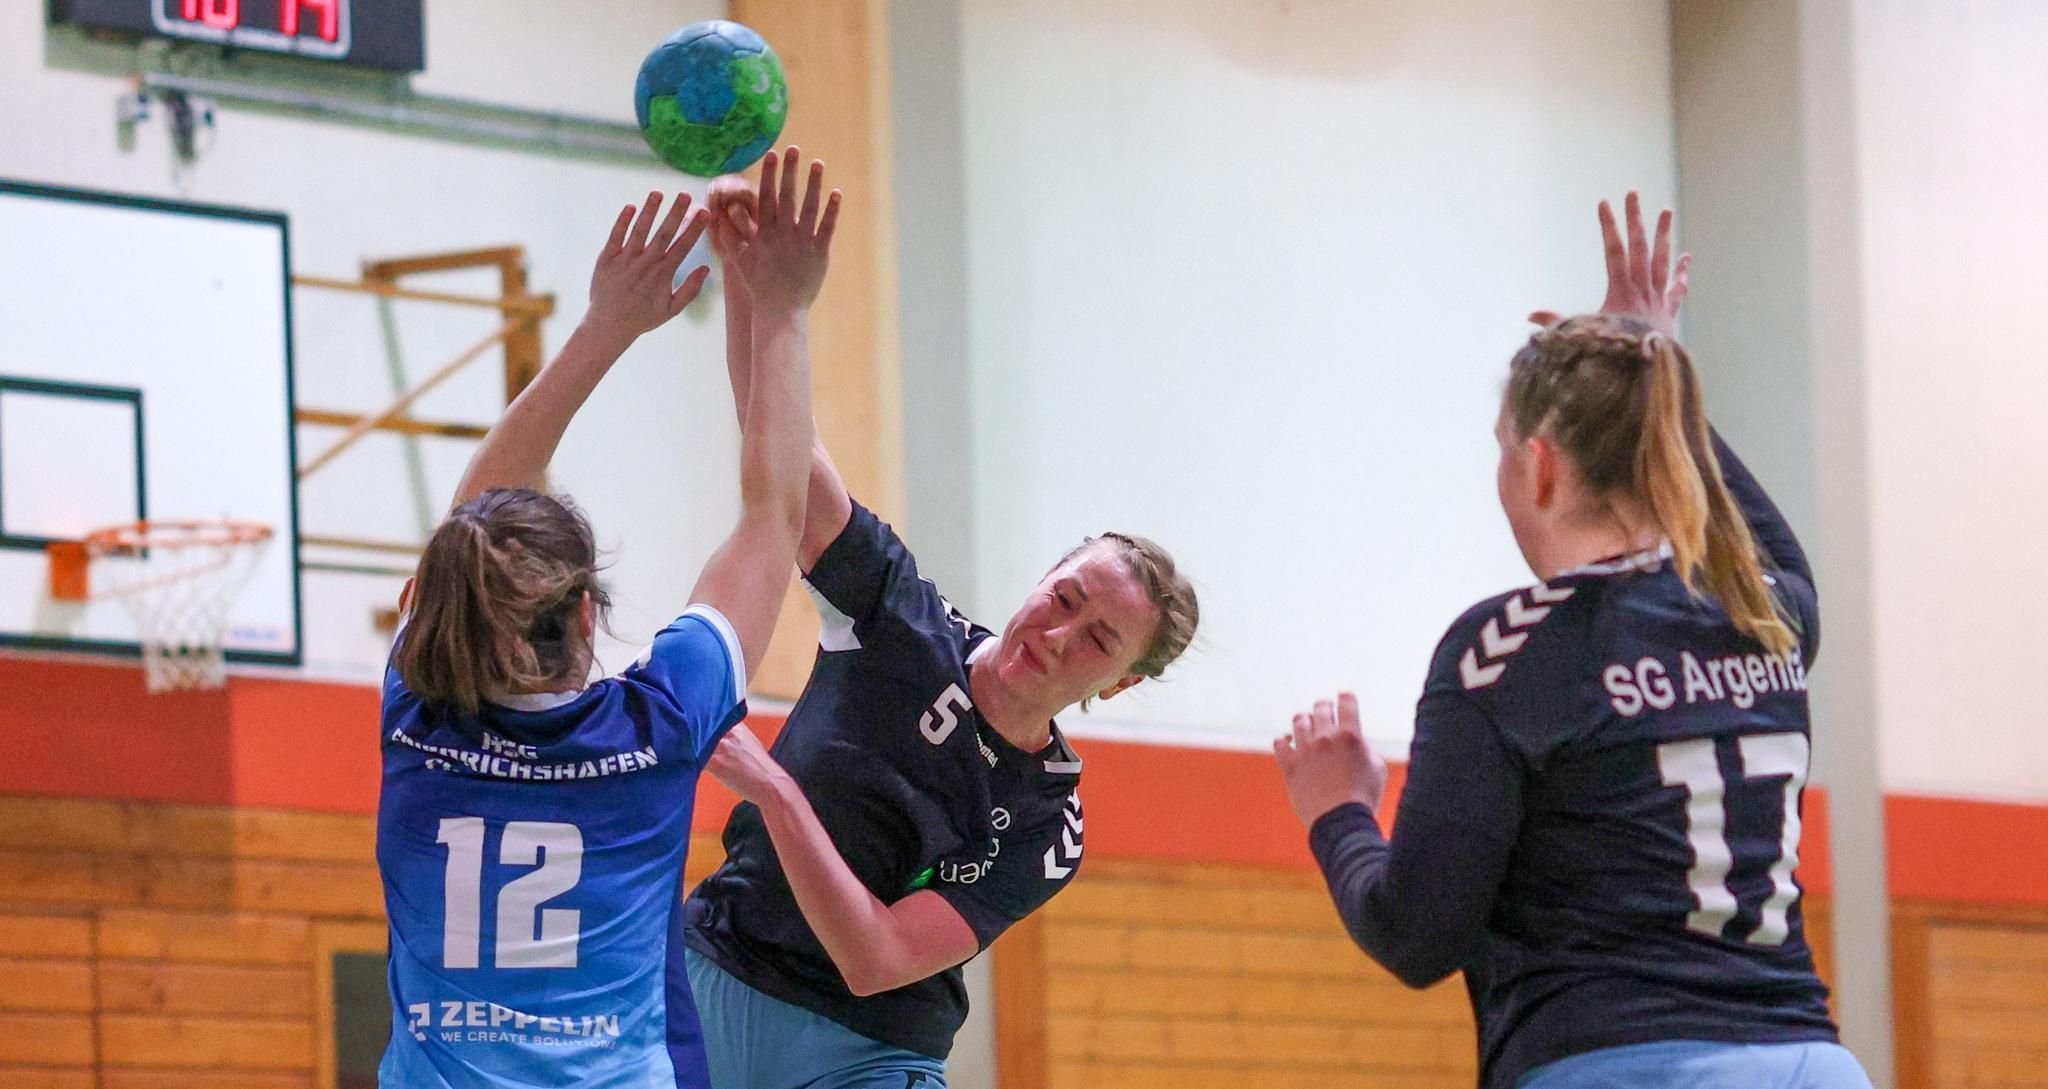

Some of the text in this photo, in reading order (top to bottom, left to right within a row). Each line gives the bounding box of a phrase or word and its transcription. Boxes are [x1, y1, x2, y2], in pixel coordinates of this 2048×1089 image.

[919, 682, 973, 745] 5
[1603, 656, 1676, 717] SG
[1656, 731, 1810, 946] 17
[435, 816, 583, 969] 12
[440, 1001, 620, 1038] ZEPPELIN
[440, 1031, 462, 1043] WE
[467, 1031, 528, 1044] CREATE
